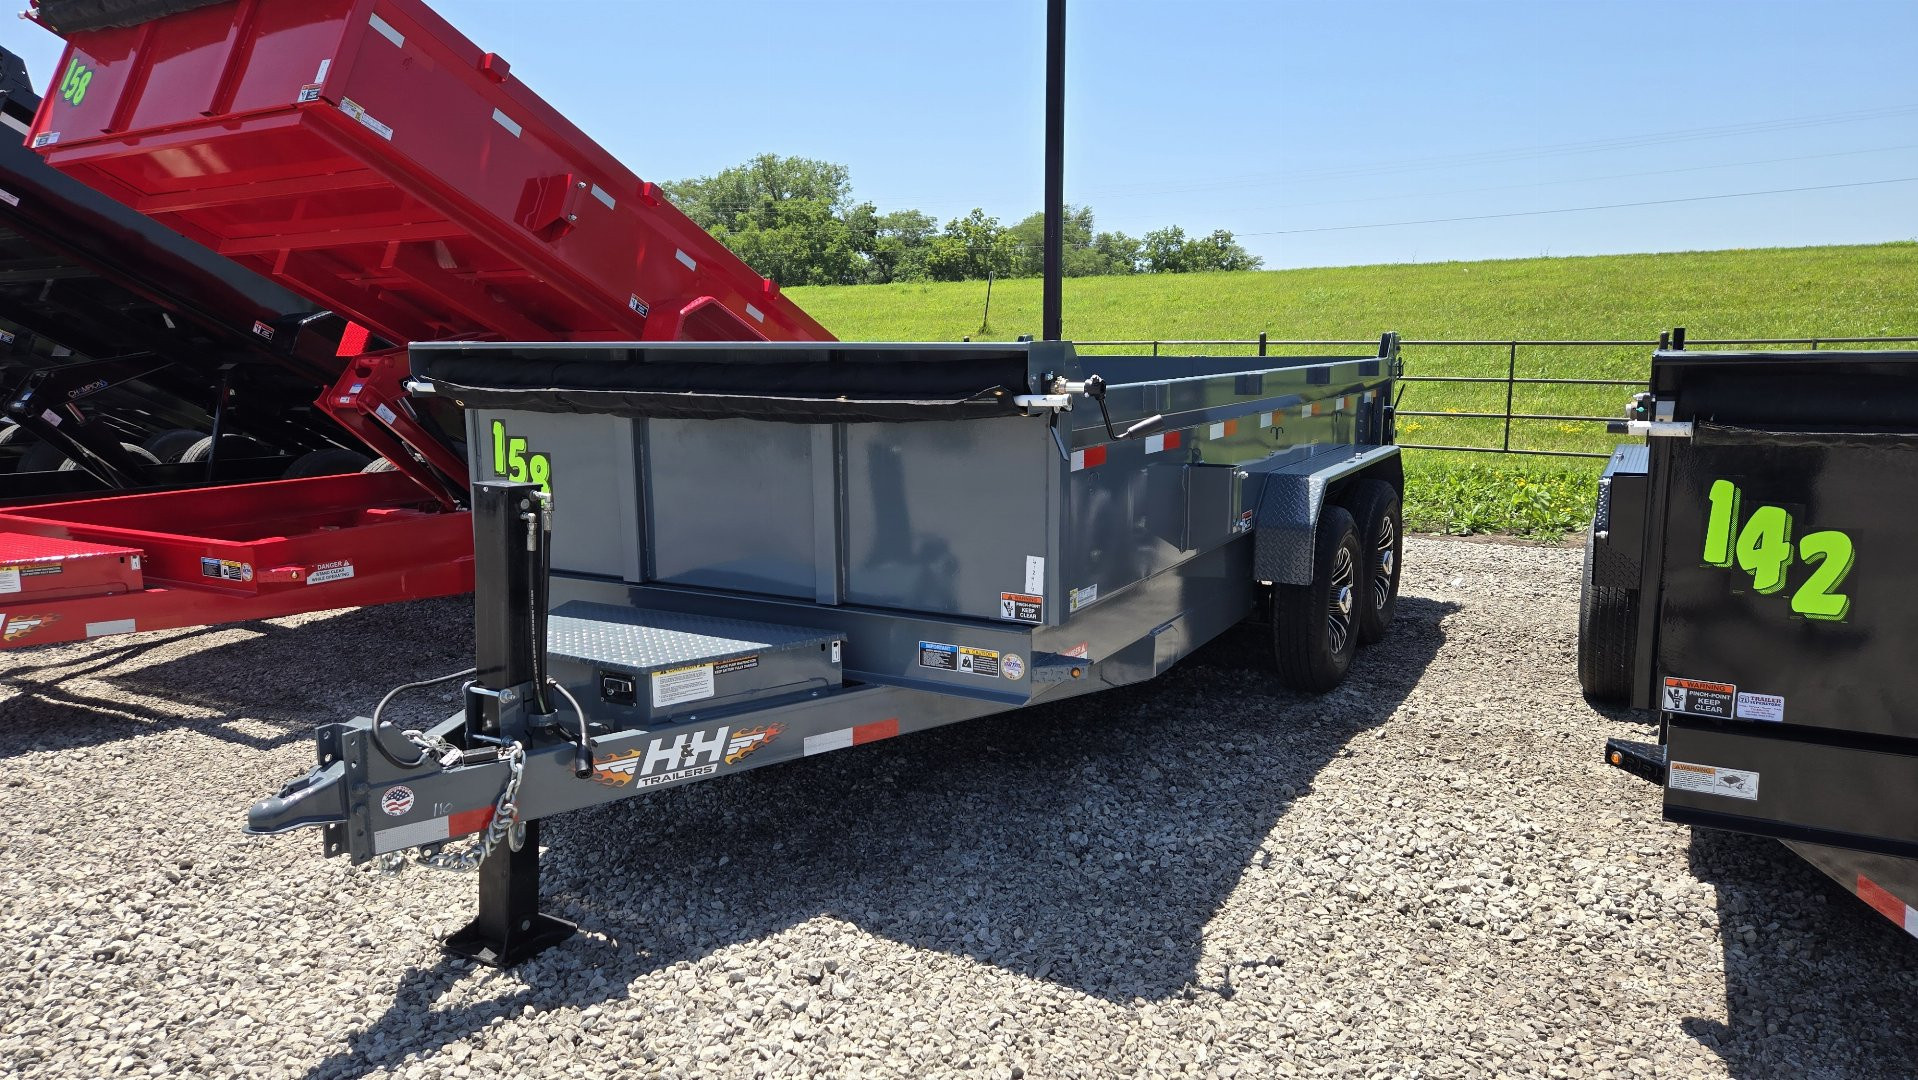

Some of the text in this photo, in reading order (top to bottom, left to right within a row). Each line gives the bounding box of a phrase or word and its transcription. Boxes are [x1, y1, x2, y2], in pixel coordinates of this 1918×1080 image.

[61, 58, 93, 106] 158
[1703, 479, 1855, 621] 142
[317, 560, 343, 571] DANGER
[1020, 612, 1037, 620] CLEAR
[1687, 681, 1726, 692] WARNING
[1689, 690, 1732, 701] PINCH-POINT
[1750, 696, 1782, 704] TRAILER
[1698, 697, 1721, 706] KEEP
[1694, 704, 1723, 713] CLEAR
[640, 726, 730, 776] H&H
[1681, 764, 1711, 774] WARNING
[642, 765, 714, 786] TRAILERS
